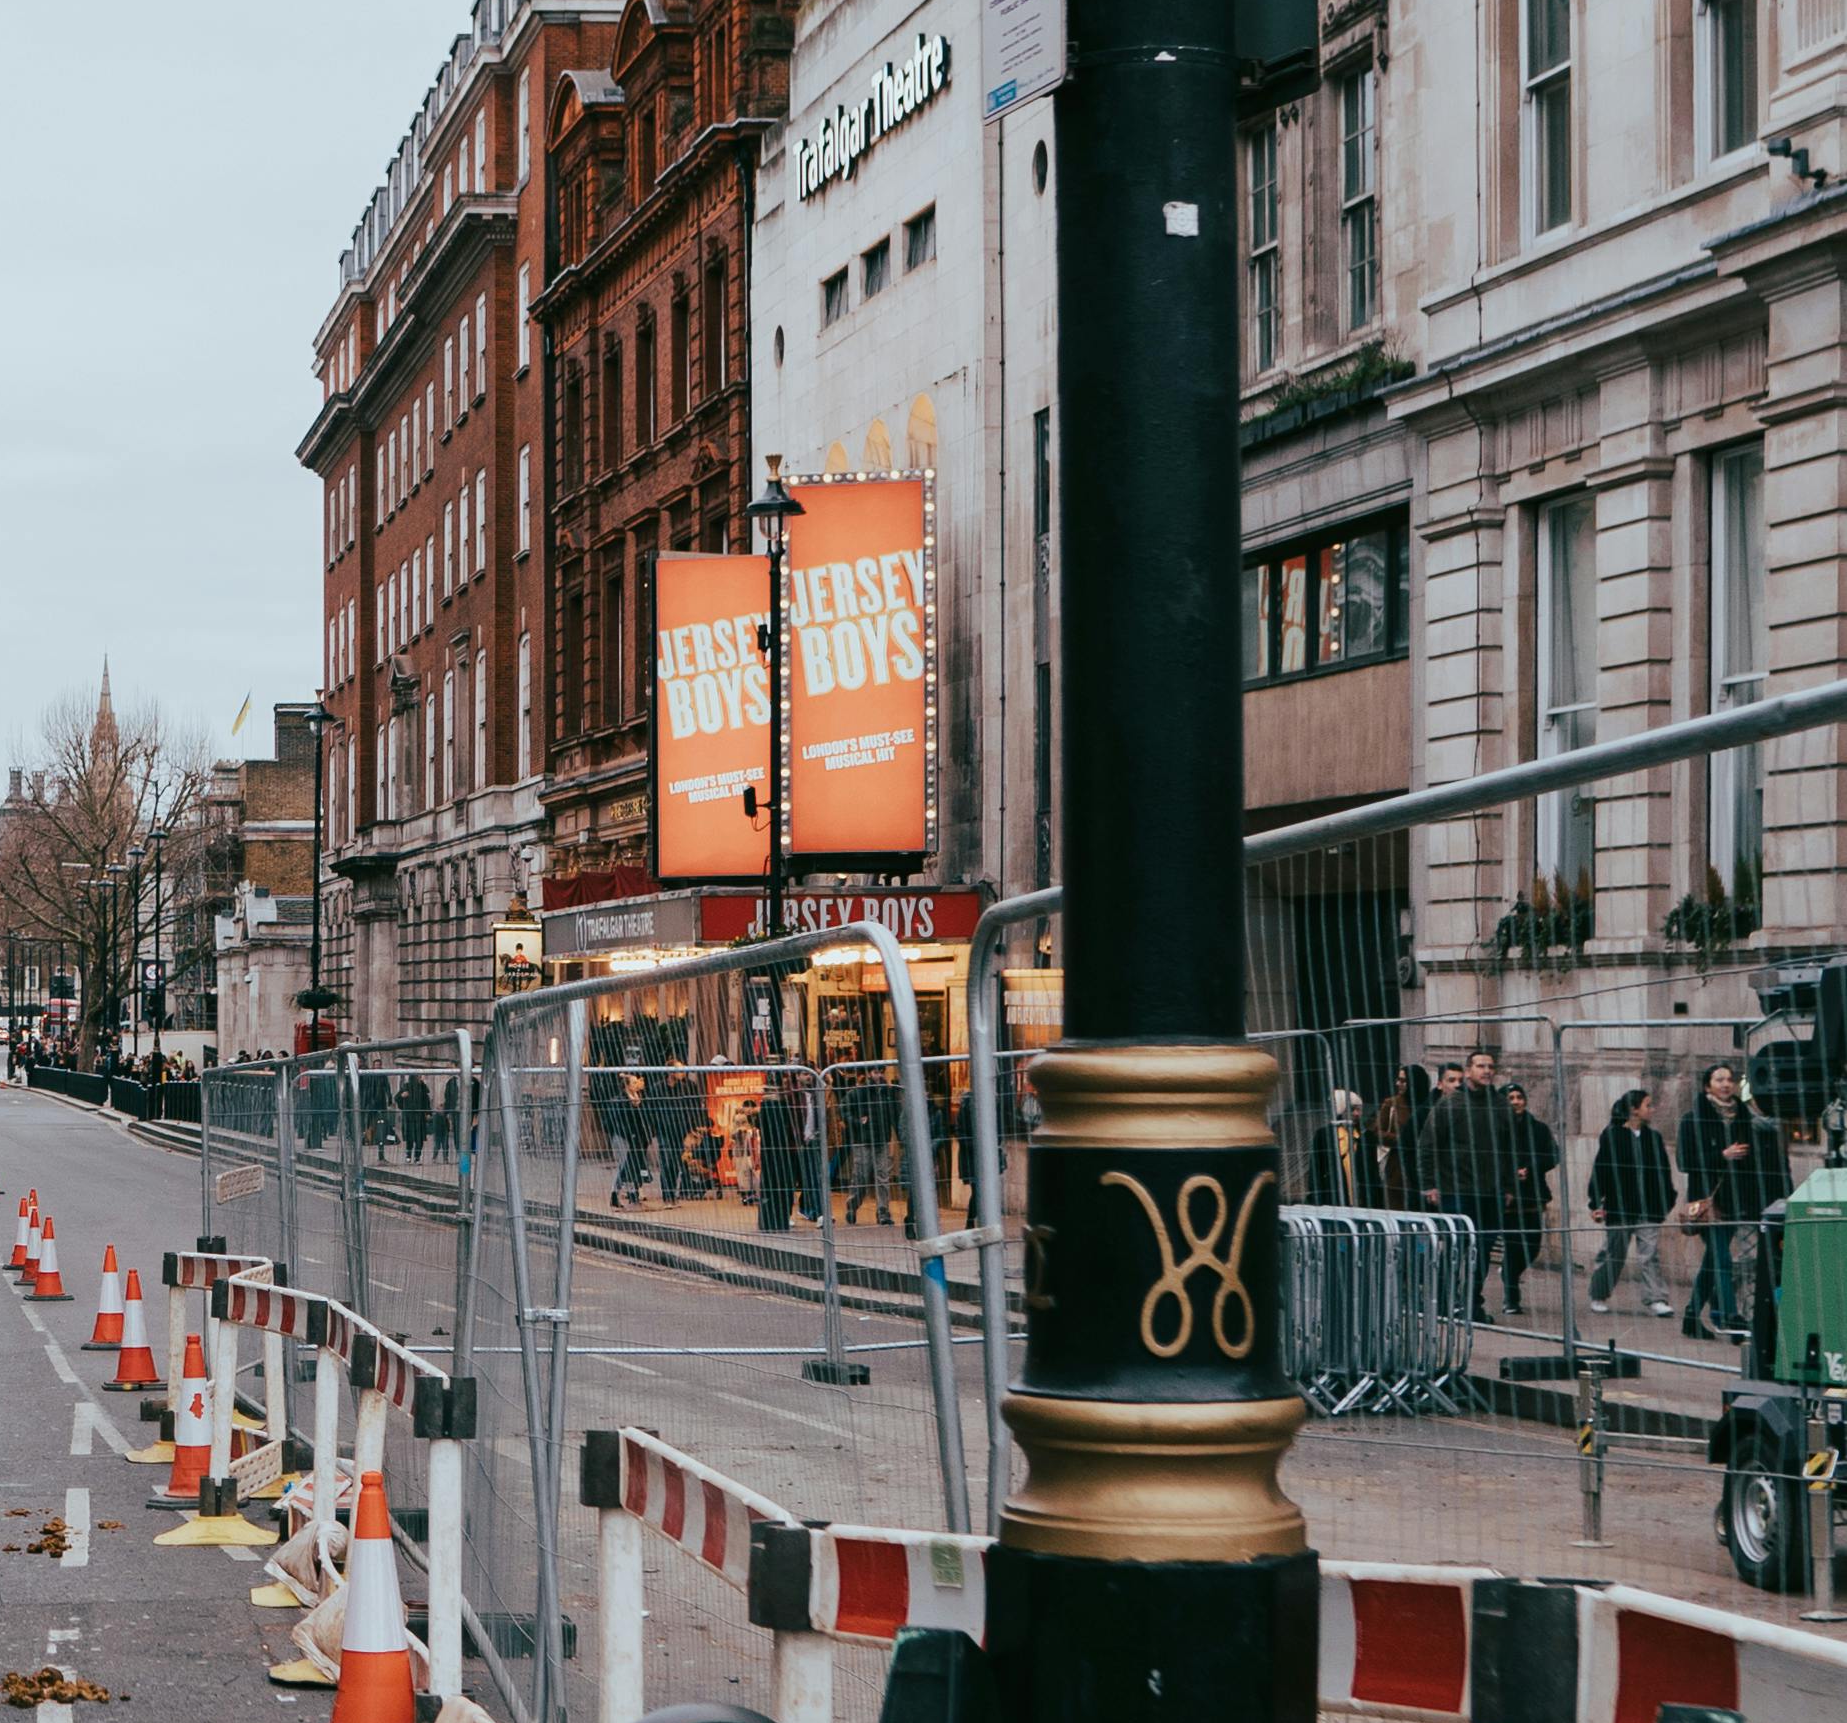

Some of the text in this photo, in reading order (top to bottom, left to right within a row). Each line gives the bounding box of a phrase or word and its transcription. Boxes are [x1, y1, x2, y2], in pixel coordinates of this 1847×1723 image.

[793, 33, 947, 202] Trafalgar Theatre
[790, 548, 924, 627] JERSEY
[799, 609, 924, 697] BOYS
[665, 664, 771, 740] BOYS
[802, 728, 916, 760] LONDON'S MUST-SEE
[825, 746, 896, 771] MUSICAL HIT
[688, 783, 732, 804] MUSICAL
[717, 767, 765, 787] MUST-SEE
[587, 911, 654, 940] TRAFALGAR THEATRE
[747, 897, 934, 939] JRSEY BOYS
